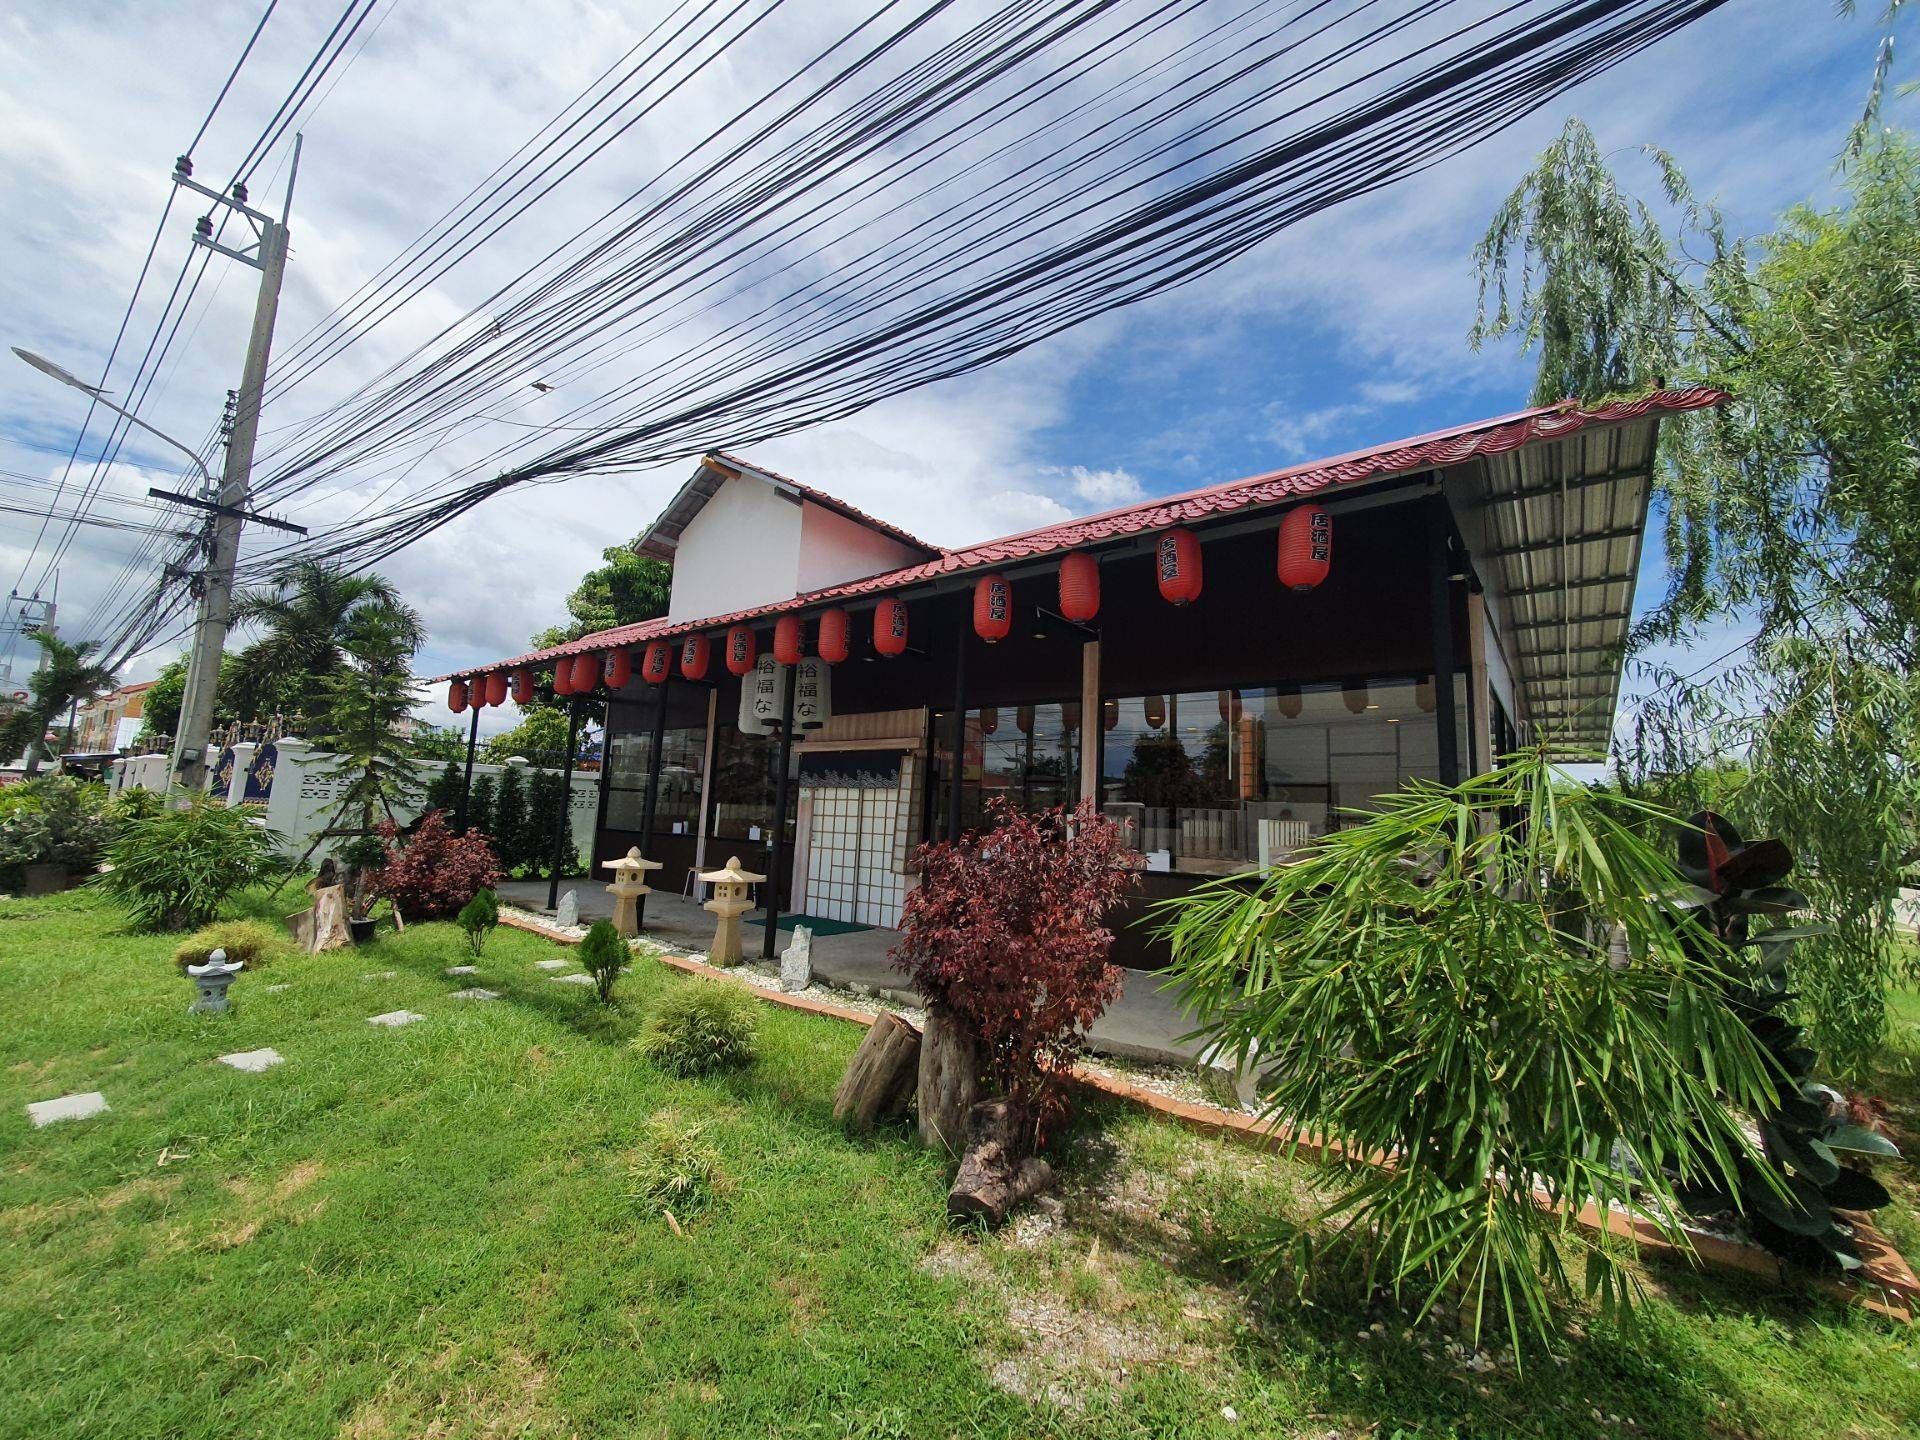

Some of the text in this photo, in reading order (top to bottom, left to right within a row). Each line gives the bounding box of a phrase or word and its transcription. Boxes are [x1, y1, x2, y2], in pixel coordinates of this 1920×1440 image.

[1159, 536, 1180, 582] 居酒屋
[1310, 512, 1329, 562] 居酒屋
[989, 582, 1008, 622] 居酒屋
